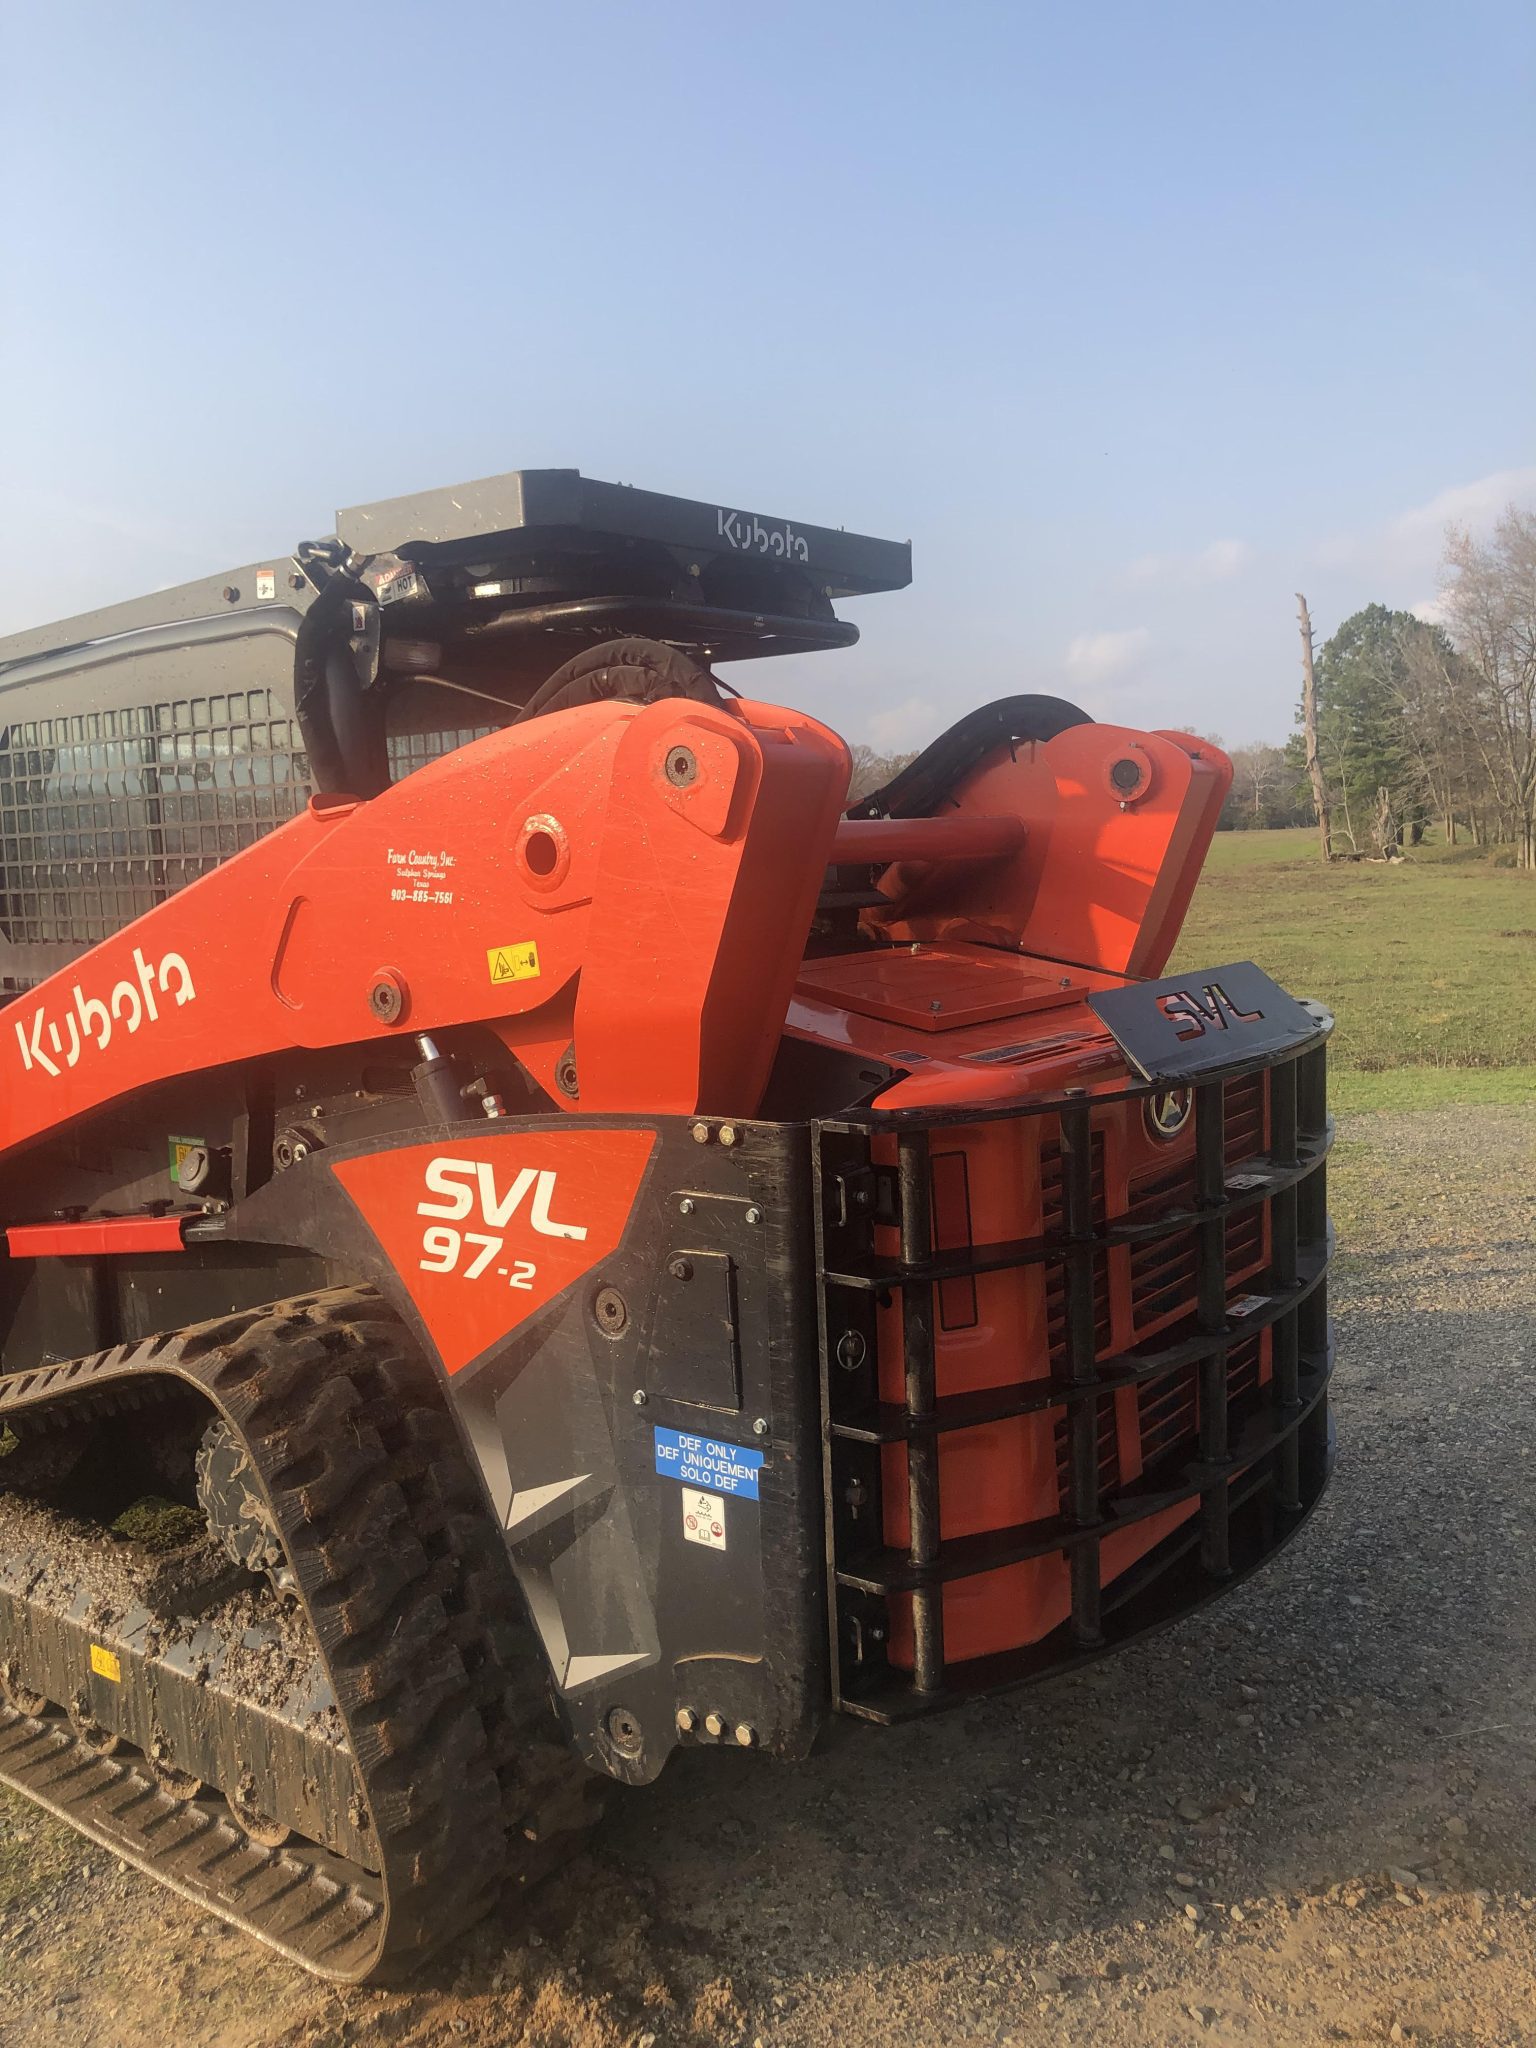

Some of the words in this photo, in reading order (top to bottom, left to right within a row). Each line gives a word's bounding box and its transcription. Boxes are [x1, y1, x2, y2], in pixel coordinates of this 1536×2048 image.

[718, 509, 809, 562] Kubota
[397, 575, 412, 592] HOT
[413, 878, 430, 888] Texas
[15, 948, 196, 1077] Kubota
[1156, 983, 1265, 1042] SVL
[417, 1157, 587, 1240] SVL
[419, 1226, 537, 1290] 97-2
[657, 1444, 679, 1460] DEF
[678, 1435, 702, 1451] DEF
[706, 1443, 737, 1461] ONLY
[680, 1465, 711, 1484] SOLO
[715, 1474, 738, 1491] DEF
